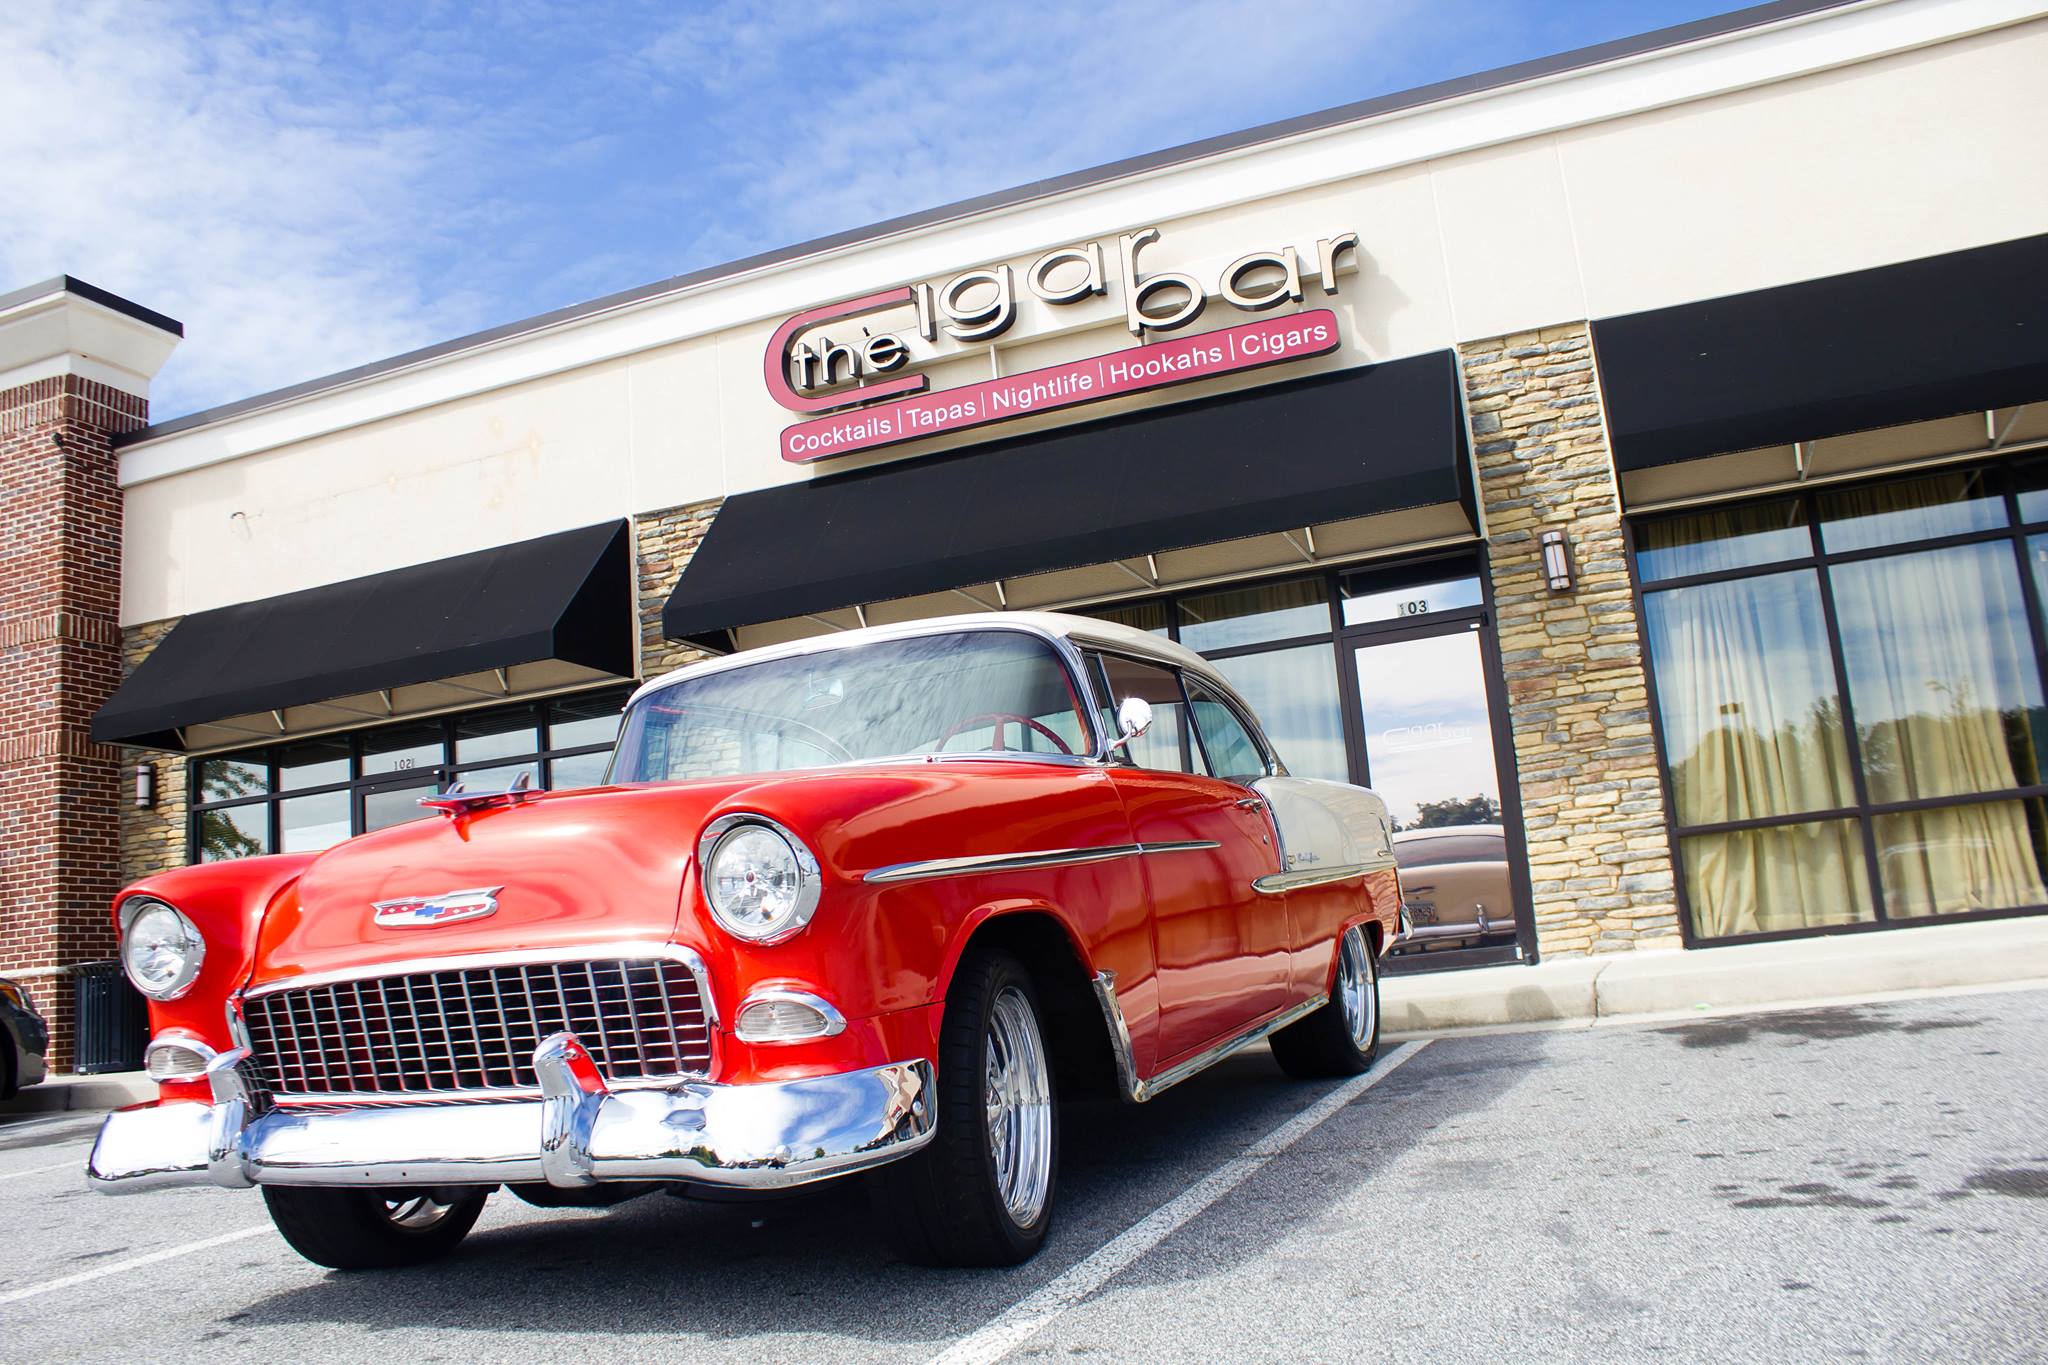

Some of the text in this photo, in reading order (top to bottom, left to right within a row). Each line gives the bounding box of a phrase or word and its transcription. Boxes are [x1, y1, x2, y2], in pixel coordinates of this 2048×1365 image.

[1119, 231, 1360, 337] bar
[788, 324, 1328, 453] Cocktails Tapas Nightlife Hookahs Cigars
[791, 333, 910, 390] the
